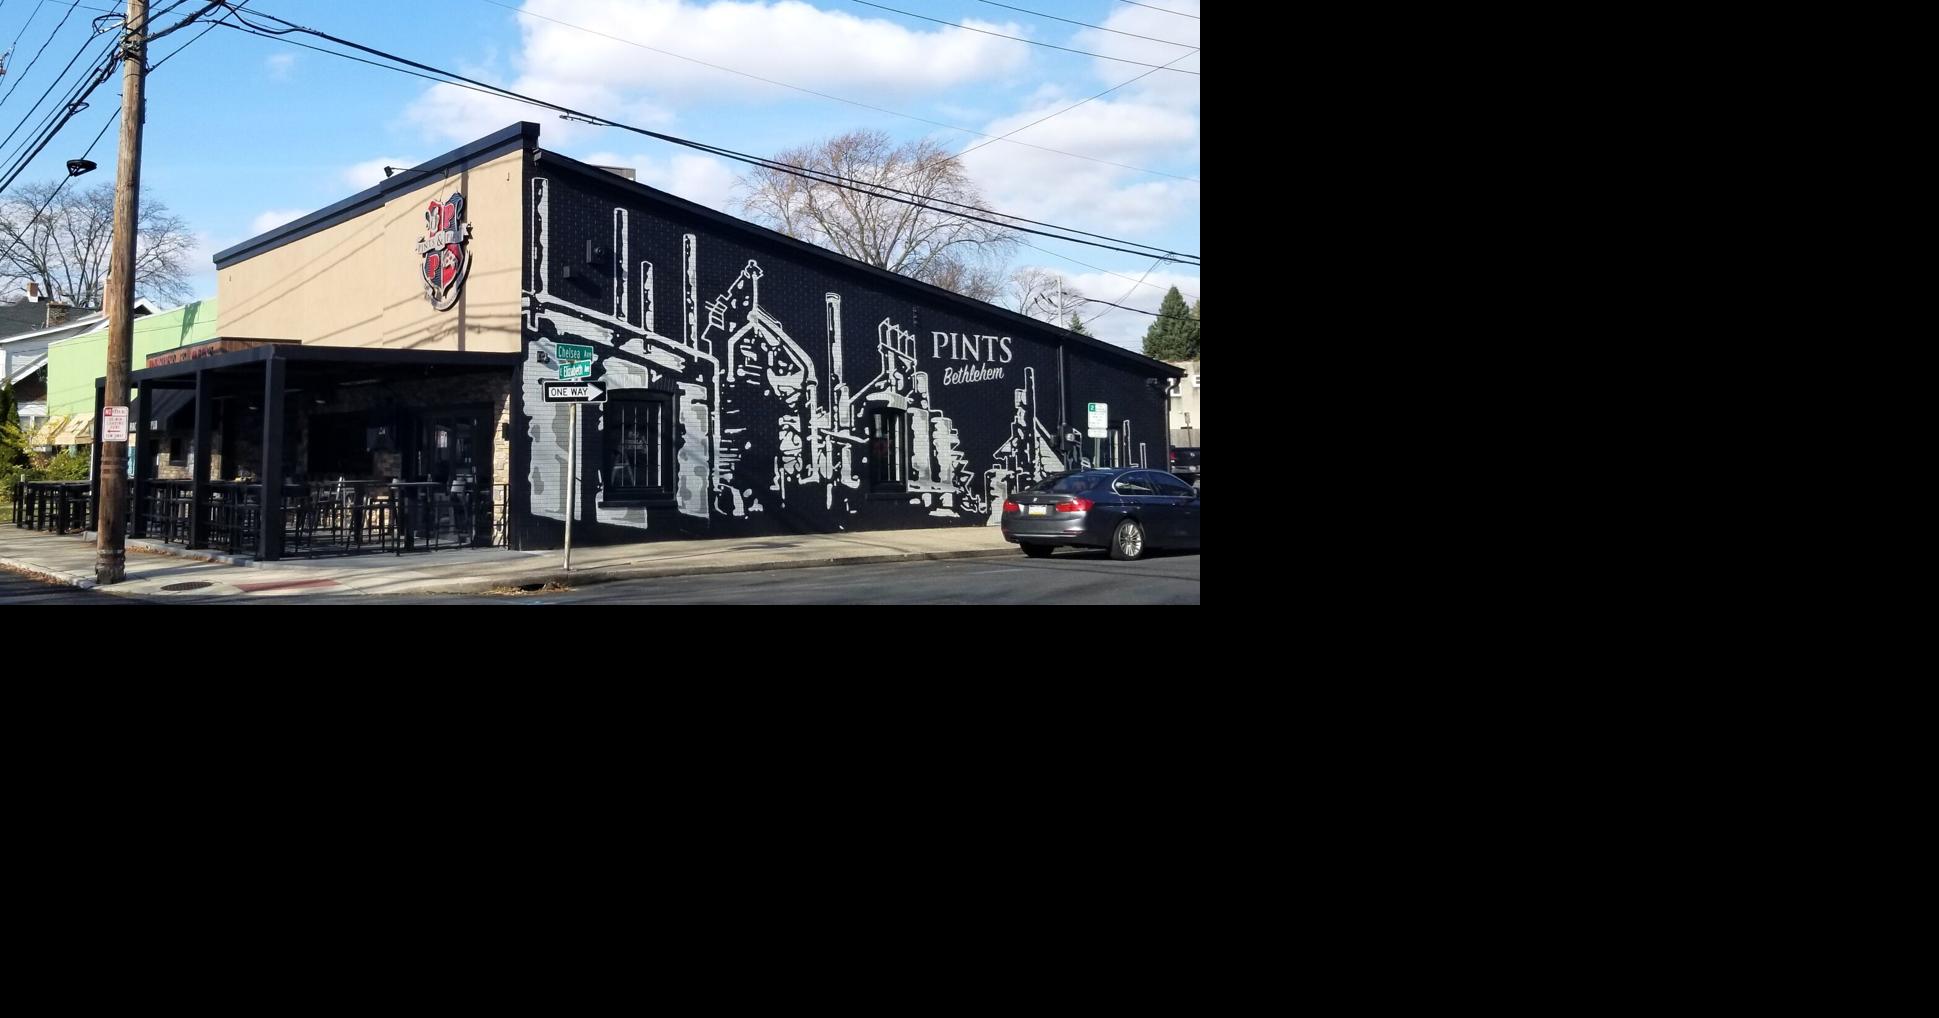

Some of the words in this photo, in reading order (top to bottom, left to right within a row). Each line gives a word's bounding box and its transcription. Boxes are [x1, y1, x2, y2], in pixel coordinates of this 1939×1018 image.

[558, 345, 581, 360] Chelsea
[931, 331, 1013, 363] PINTS
[943, 362, 1005, 386] Bethlehem
[550, 387, 568, 397] ONE
[570, 387, 588, 397] WAY
